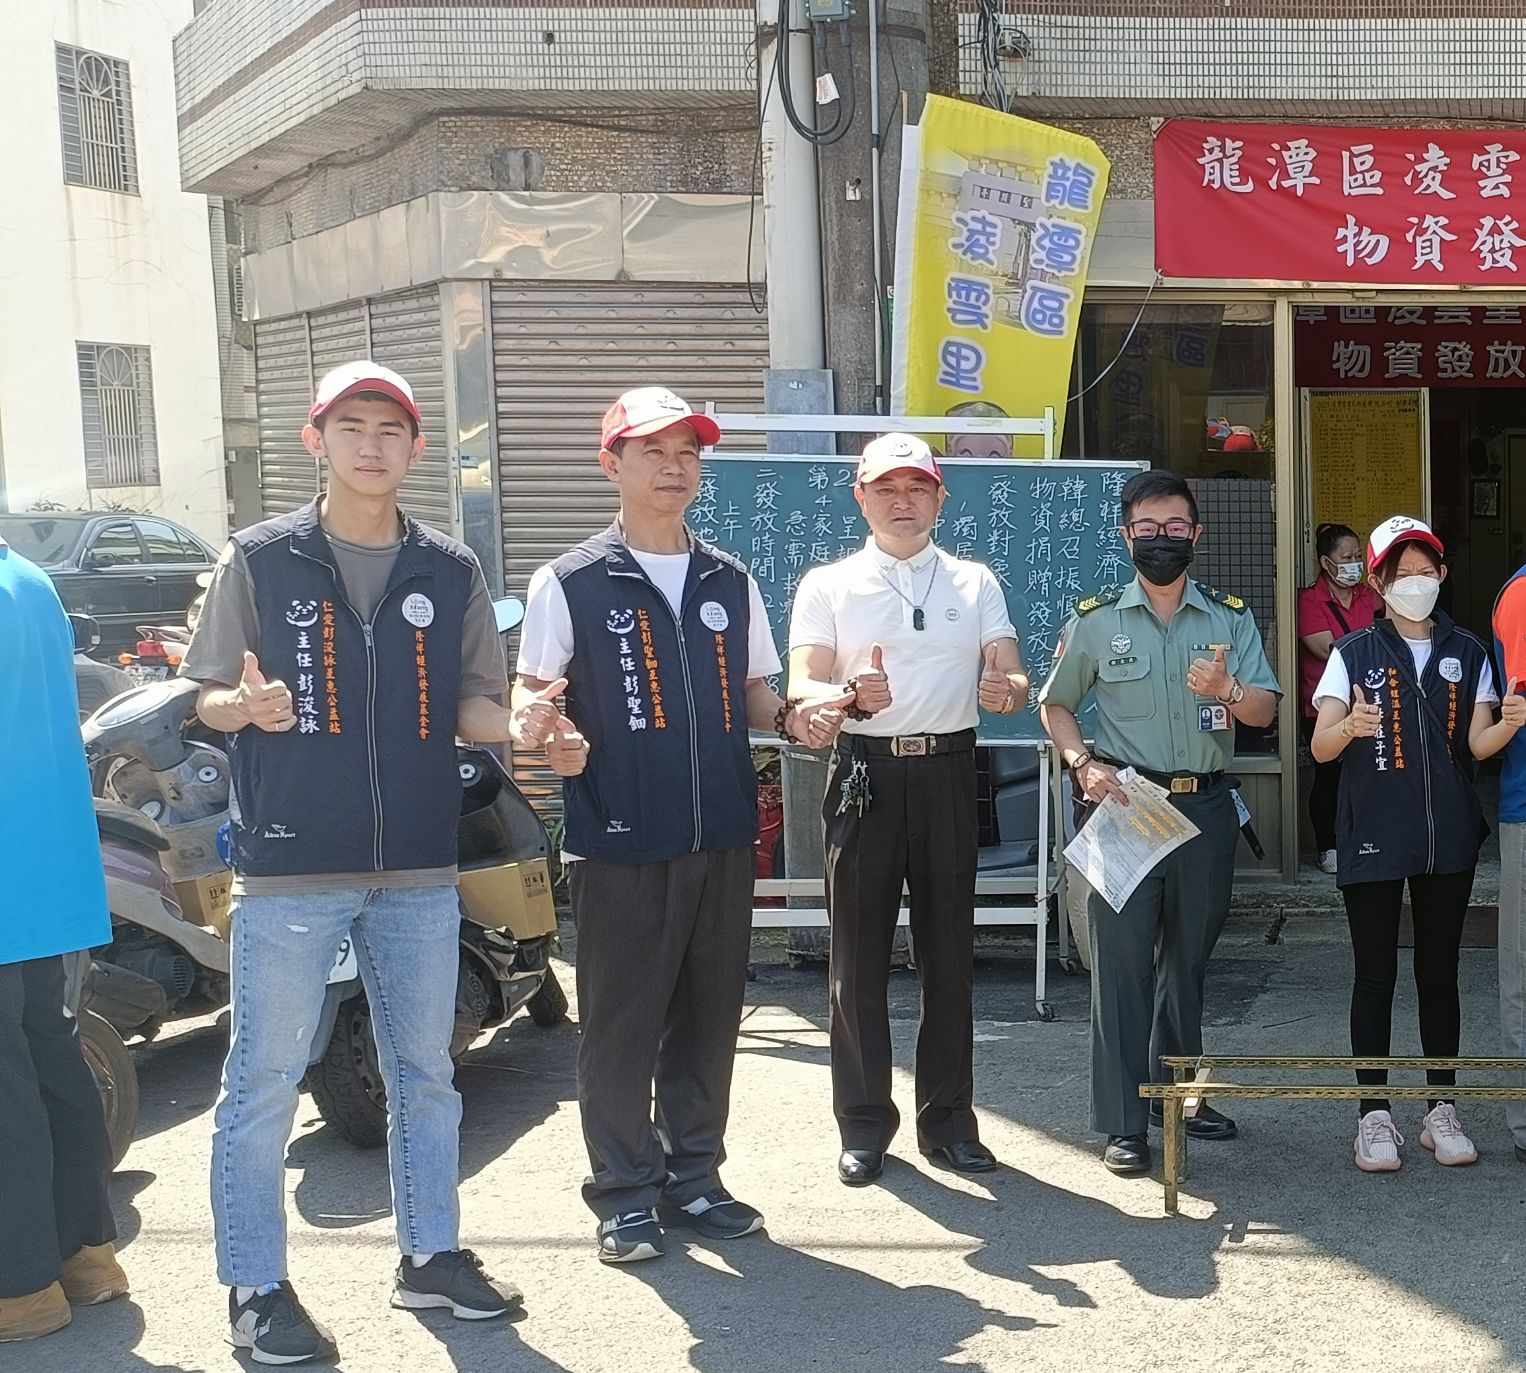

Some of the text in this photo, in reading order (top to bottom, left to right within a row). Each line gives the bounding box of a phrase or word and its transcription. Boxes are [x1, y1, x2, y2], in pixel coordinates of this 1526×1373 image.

[938, 214, 998, 391] 凌雲里
[1024, 157, 1095, 336] 龍潭區
[296, 631, 321, 735] 主任彭浚詠
